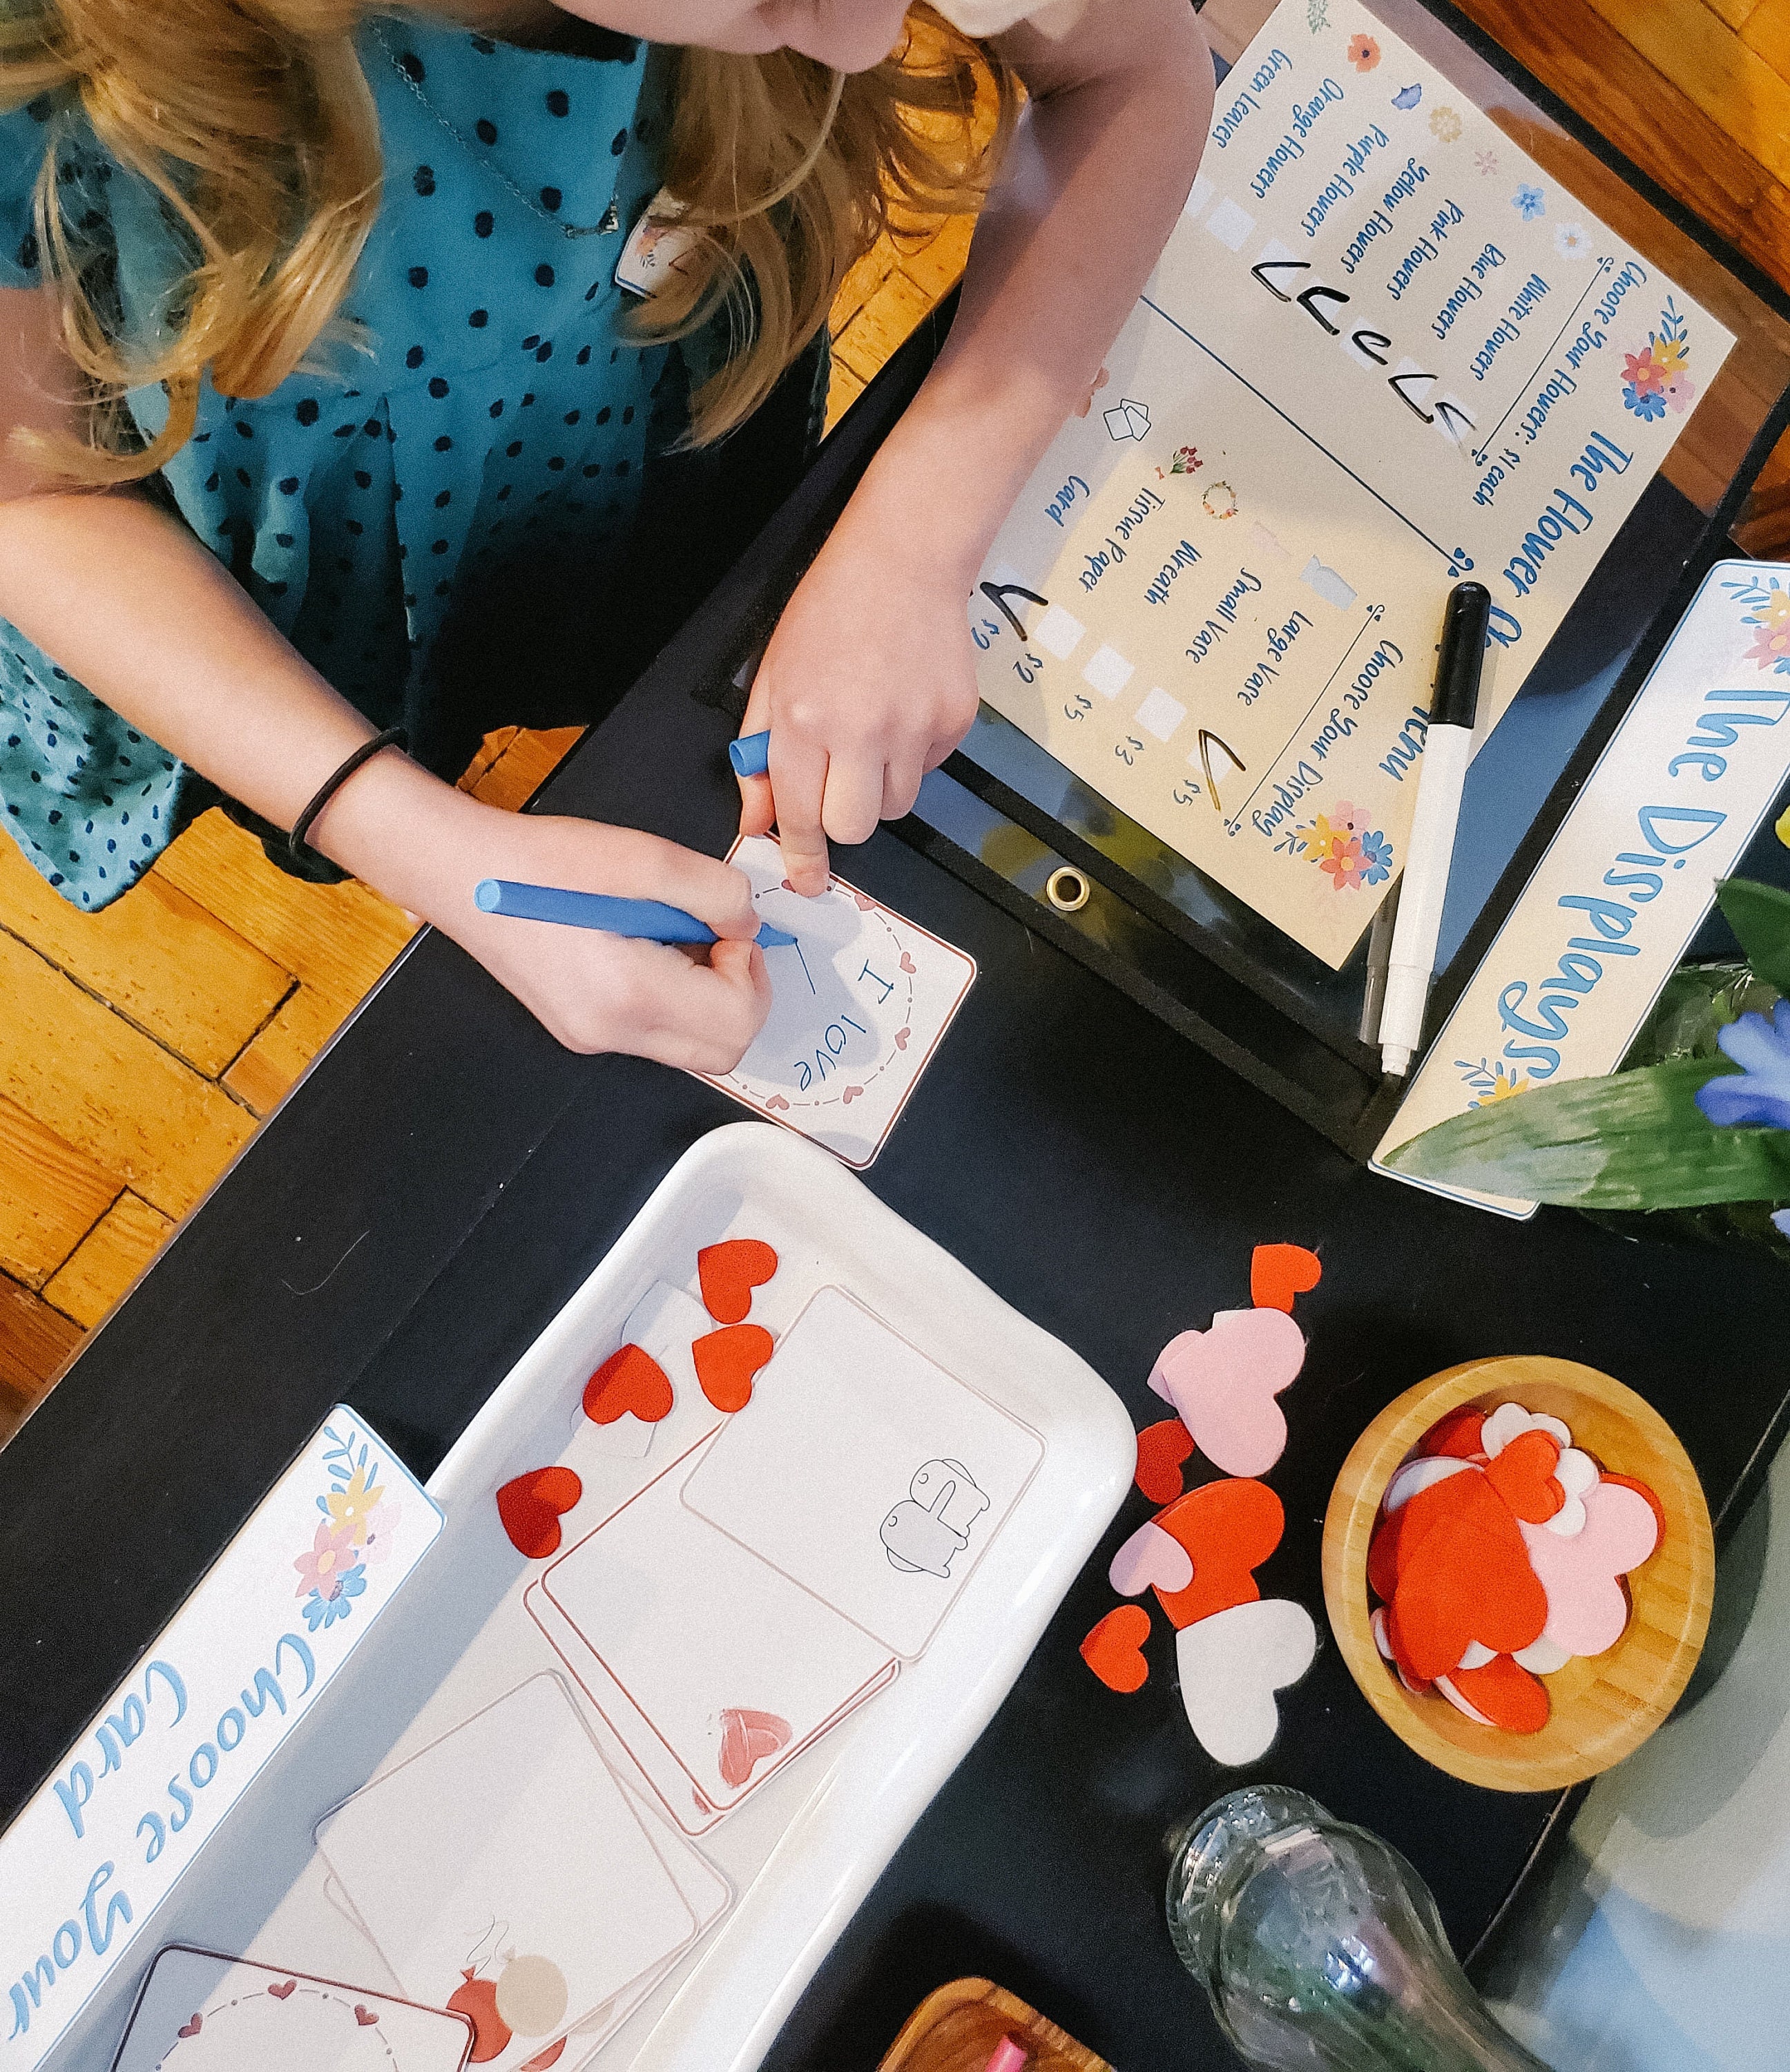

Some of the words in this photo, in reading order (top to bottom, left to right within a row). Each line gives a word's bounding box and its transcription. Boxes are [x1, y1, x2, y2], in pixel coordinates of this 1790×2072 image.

[1249, 48, 1293, 93] Green
[1216, 92, 1261, 148] Leaves
[1292, 77, 1345, 138] Orange
[1250, 135, 1305, 199] Flowers
[1342, 124, 1389, 177] Purple
[1300, 173, 1354, 238] Flowers
[1383, 157, 1430, 213] Yellow
[1340, 210, 1394, 274] Flowers
[1430, 199, 1465, 242] Pink
[1386, 237, 1438, 301] Flowers
[1470, 243, 1506, 280] Blue
[1431, 276, 1483, 340] Flowers
[1508, 273, 1551, 320] White
[1594, 261, 1647, 325] Choose
[1470, 318, 1521, 381] Flowers
[1565, 321, 1608, 370] Your
[1472, 465, 1505, 506] each
[1570, 430, 1634, 492] The
[1044, 475, 1090, 527] Card
[1115, 487, 1166, 540] Tissue
[1079, 538, 1127, 591] Paper
[1144, 539, 1202, 604] Wreath
[1503, 488, 1594, 598] Flower
[1215, 567, 1262, 624] Small
[1185, 620, 1229, 664] Vase
[1267, 611, 1313, 662] Large
[1237, 662, 1280, 707] Vase
[1343, 640, 1404, 710] Choose
[1310, 708, 1358, 760] Your
[1668, 689, 1790, 783] The
[1251, 760, 1324, 837] Display
[1497, 805, 1728, 1079] Displays
[857, 959, 894, 1005] I
[793, 1014, 867, 1091] love
[52, 1660, 187, 1839] Card
[135, 1633, 316, 1864] Choose
[8, 1861, 133, 2042] Your
